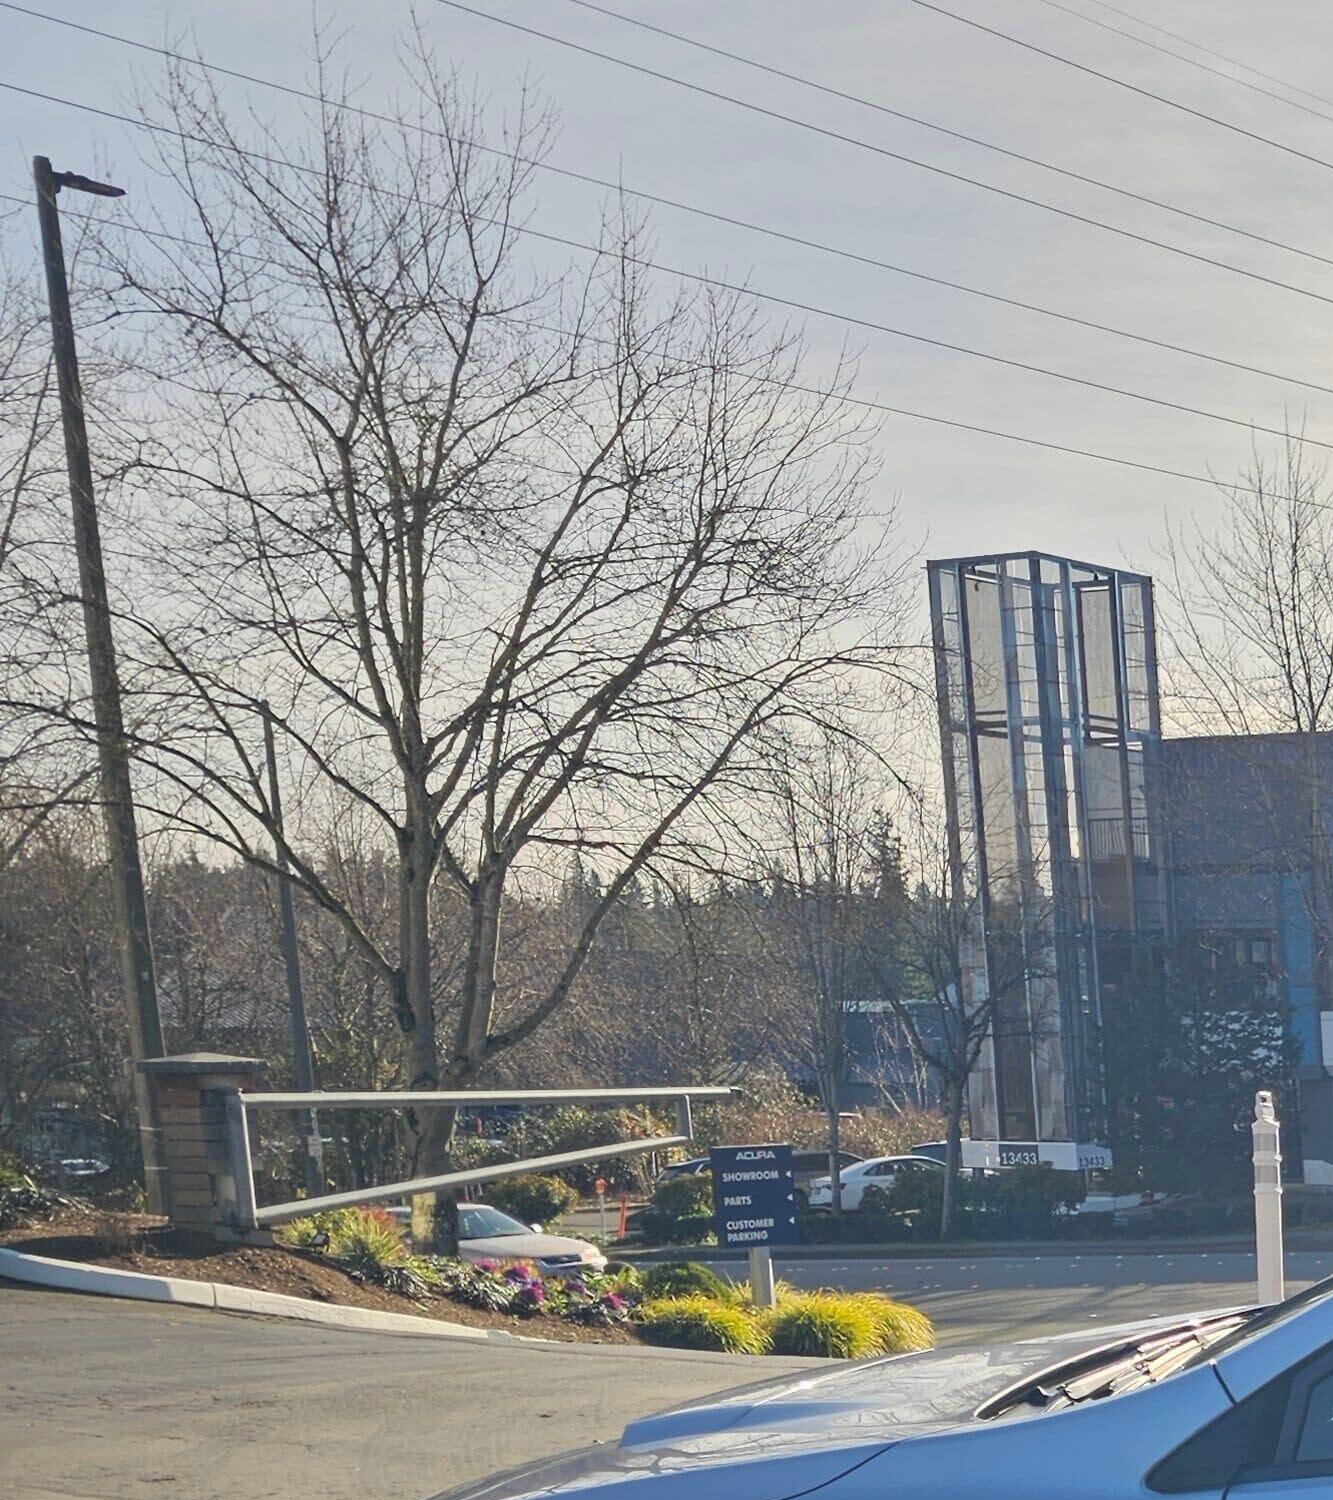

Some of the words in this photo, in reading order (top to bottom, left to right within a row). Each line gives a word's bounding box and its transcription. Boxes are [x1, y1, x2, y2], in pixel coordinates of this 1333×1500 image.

[735, 1150, 776, 1160] ACURA
[1001, 1152, 1037, 1165] 13433
[1079, 1156, 1105, 1167] 13433
[722, 1170, 779, 1182] SHOWROOM
[724, 1195, 752, 1206] PARTS
[726, 1218, 775, 1230] CUSTOMER
[727, 1230, 768, 1242] PARKING
